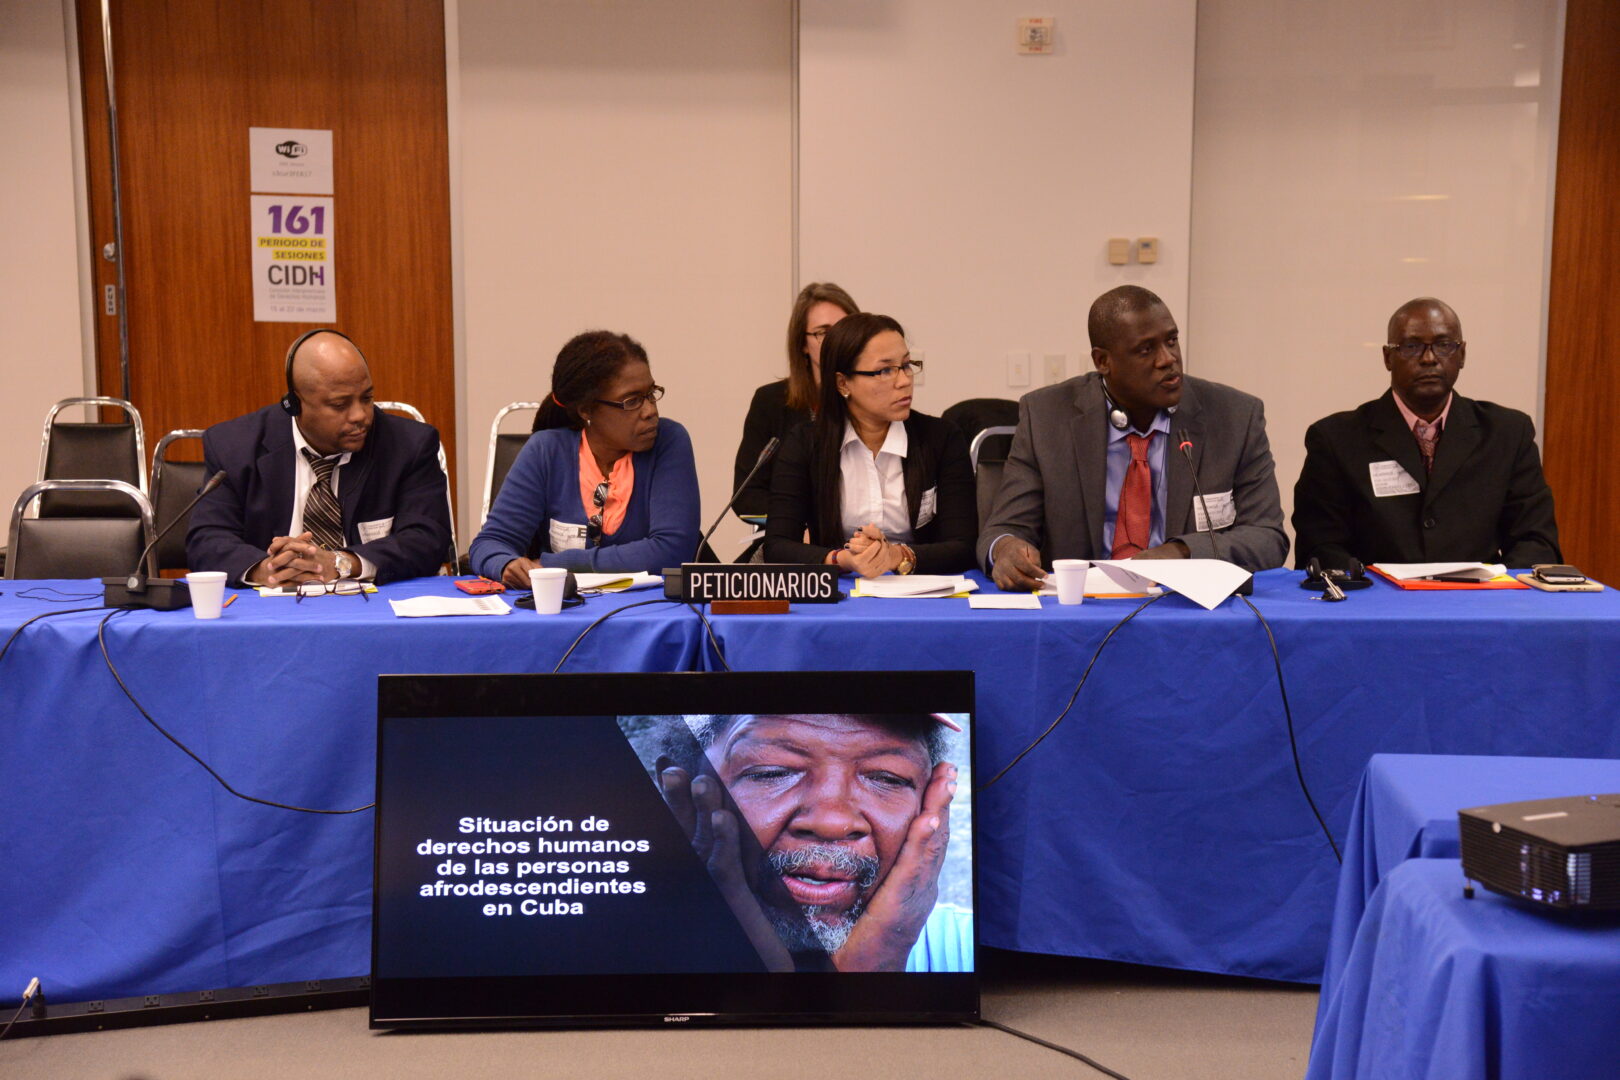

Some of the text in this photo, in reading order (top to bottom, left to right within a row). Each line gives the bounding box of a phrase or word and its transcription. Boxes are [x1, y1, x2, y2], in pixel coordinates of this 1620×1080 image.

[268, 205, 324, 235] 161
[260, 238, 324, 248] PERIODO DE
[275, 251, 324, 260] SESIONES
[268, 264, 324, 286] CIDH
[690, 572, 832, 599] PETICIONARIOS
[458, 816, 610, 834] Situación de
[416, 837, 650, 855] derechos humanos
[436, 859, 630, 878] de las personas
[419, 878, 647, 896] afrodescendientes
[482, 899, 584, 916] en Cuba
